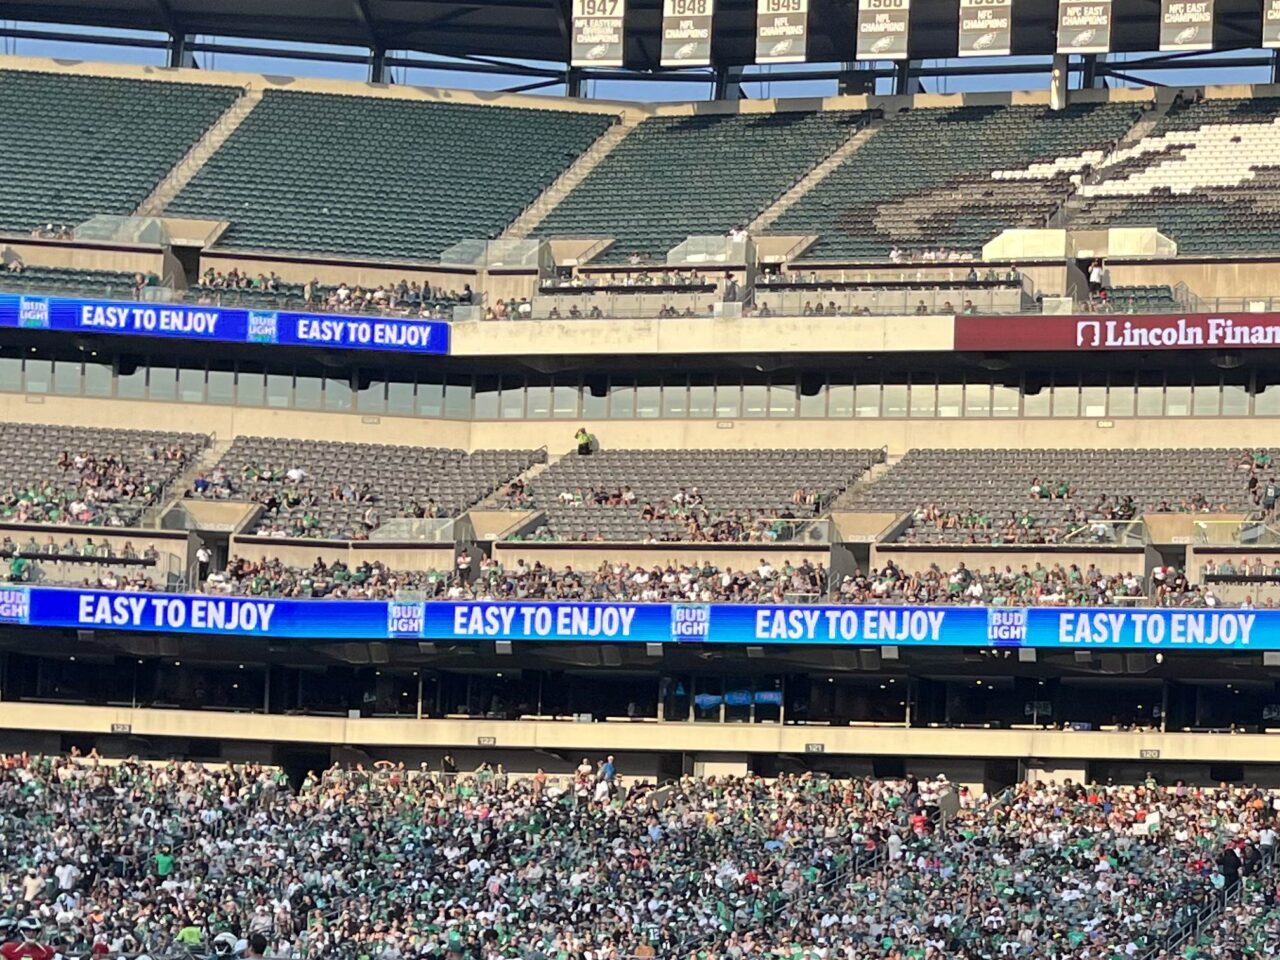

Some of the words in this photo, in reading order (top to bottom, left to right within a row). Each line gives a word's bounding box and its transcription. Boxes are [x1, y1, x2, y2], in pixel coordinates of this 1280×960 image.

[580, 0, 618, 15] 1947
[671, 0, 706, 14] 1948
[1083, 7, 1104, 15] EAST
[1186, 3, 1206, 12] EAST
[963, 18, 1007, 30] CHAMPIONS
[1062, 15, 1107, 26] CHAMPIONS
[1164, 12, 1210, 23] CHAMPIONS
[665, 29, 708, 39] CHAMPIONS
[760, 25, 803, 36] CHAMPIONS
[860, 22, 905, 33] CHAMPIONS
[576, 34, 619, 43] CHAMPIONS
[82, 305, 127, 330] EASY
[132, 308, 156, 331] TO
[160, 310, 218, 333] ENJOY
[298, 319, 342, 341] EASY
[347, 322, 371, 343] TO
[373, 324, 431, 346] ENJOY
[1105, 318, 1203, 347] Lincoln
[0, 603, 28, 617] GHT
[79, 595, 145, 624] EASY
[151, 599, 179, 627] TO
[191, 600, 274, 631] ENJOY
[392, 606, 420, 619] BUD
[676, 608, 706, 623] BUD
[389, 617, 423, 633] LIGHT
[454, 606, 515, 635] EASY
[520, 607, 551, 635] TO
[557, 607, 635, 636] ENJOY
[756, 610, 821, 639] EASY
[826, 610, 857, 640] TO
[864, 609, 944, 640] ENJOY
[992, 612, 1024, 626] BUD
[672, 621, 708, 637] LIGHT
[988, 625, 1026, 641] LIGHT
[1059, 612, 1125, 643] EASY
[1131, 613, 1165, 644] TO
[1171, 613, 1255, 644] ENJOY
